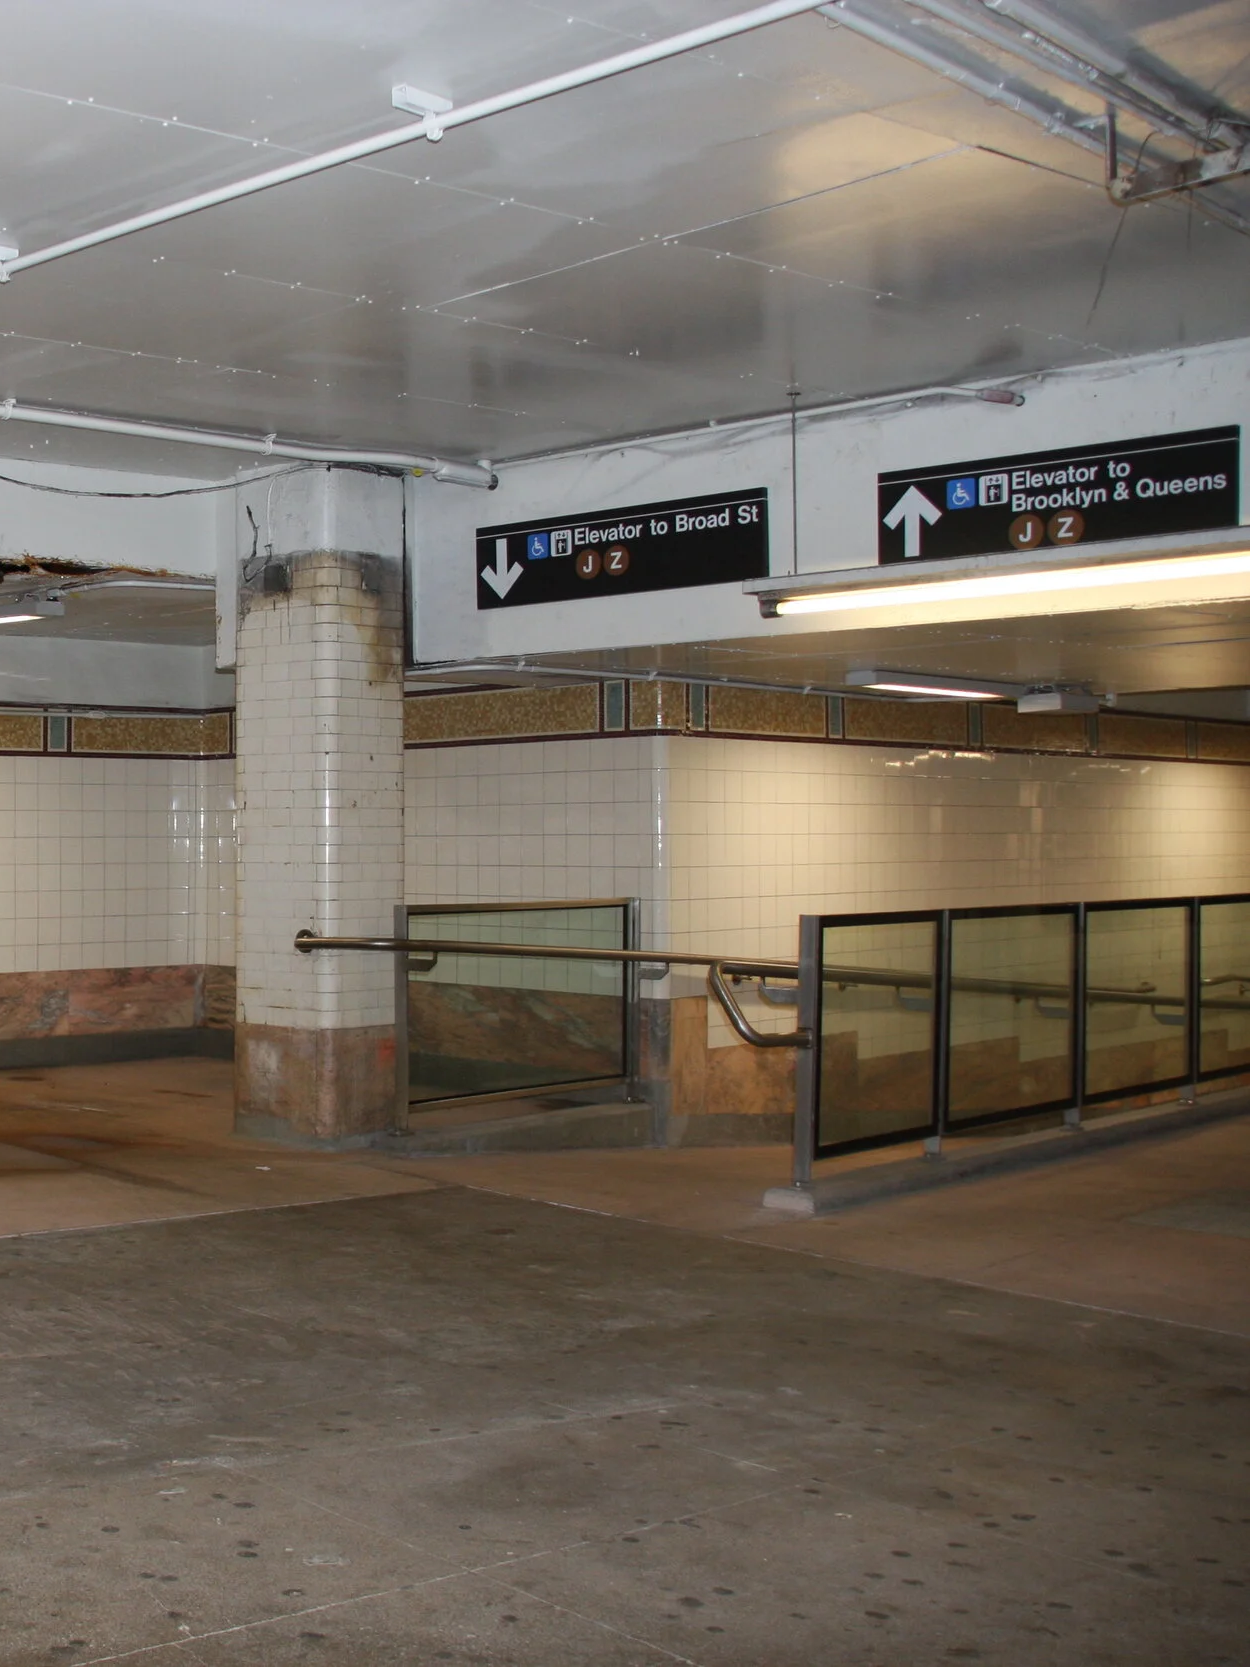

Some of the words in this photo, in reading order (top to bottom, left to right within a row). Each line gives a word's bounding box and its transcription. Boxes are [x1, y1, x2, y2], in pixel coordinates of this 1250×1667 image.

[1012, 465, 1098, 489] Elevator
[1108, 460, 1131, 478] to
[1012, 486, 1106, 512] Brooklyn
[1114, 481, 1129, 501] &
[1136, 472, 1227, 498] Queens
[574, 524, 642, 545] Elevator
[650, 519, 668, 536] to
[675, 508, 730, 533] Broad
[737, 505, 759, 524] St
[1018, 522, 1031, 542] J
[1057, 517, 1074, 538] Z
[583, 556, 593, 573] J
[610, 552, 622, 569] Z
